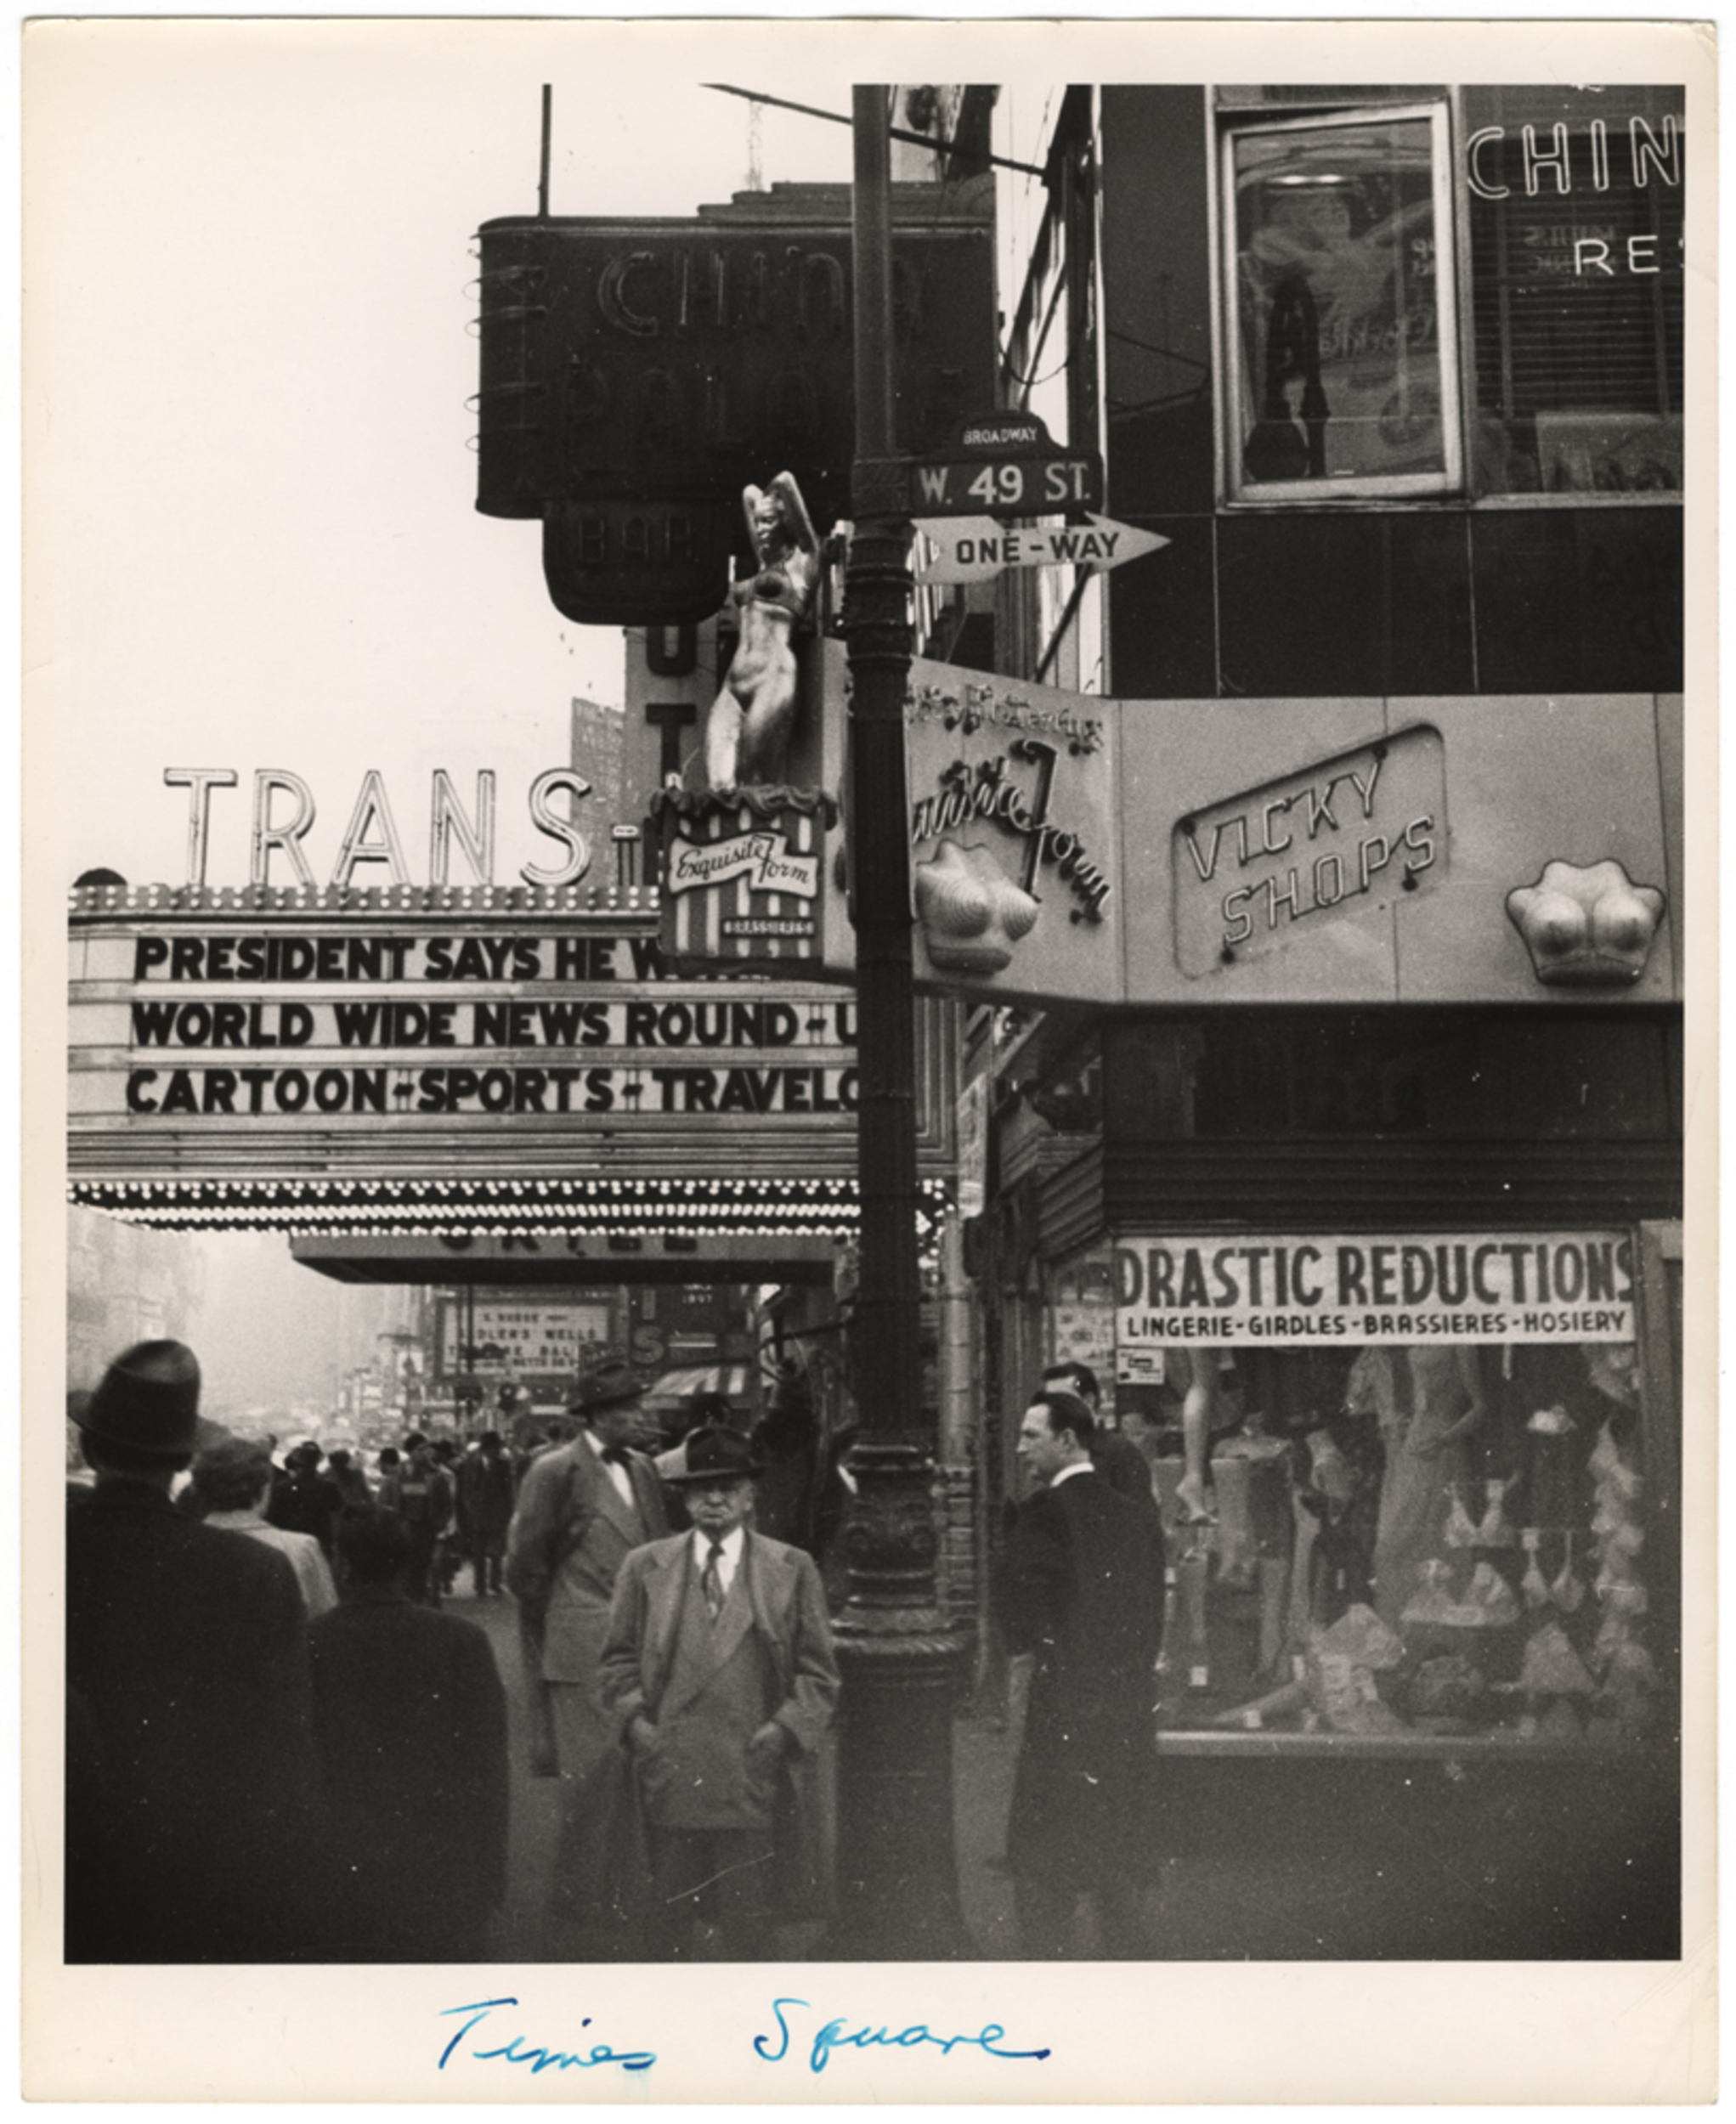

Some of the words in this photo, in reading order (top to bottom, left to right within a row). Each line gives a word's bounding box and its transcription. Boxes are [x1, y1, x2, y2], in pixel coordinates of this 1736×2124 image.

[1575, 234, 1684, 275] RE
[563, 362, 967, 447] PALAE
[963, 427, 1038, 445] BROADWAY
[919, 466, 953, 505] W.
[968, 465, 1023, 505] 49
[1044, 462, 1091, 501] ST.
[1188, 761, 1382, 882] VICKY
[676, 838, 766, 879] Exquisite
[1221, 814, 1435, 945] SHOPS
[133, 937, 416, 982] PRESIDENT
[424, 937, 541, 982] SAYS
[555, 937, 616, 982] HE
[132, 1003, 314, 1048] WORLD
[335, 1003, 457, 1048] WIDE
[472, 1003, 610, 1048] NEWS
[1117, 1245, 1324, 1308] DRASTIC
[1337, 1240, 1634, 1305] REDUCTIONS
[438, 1996, 657, 2074] Times
[753, 1997, 1051, 2072] Square
